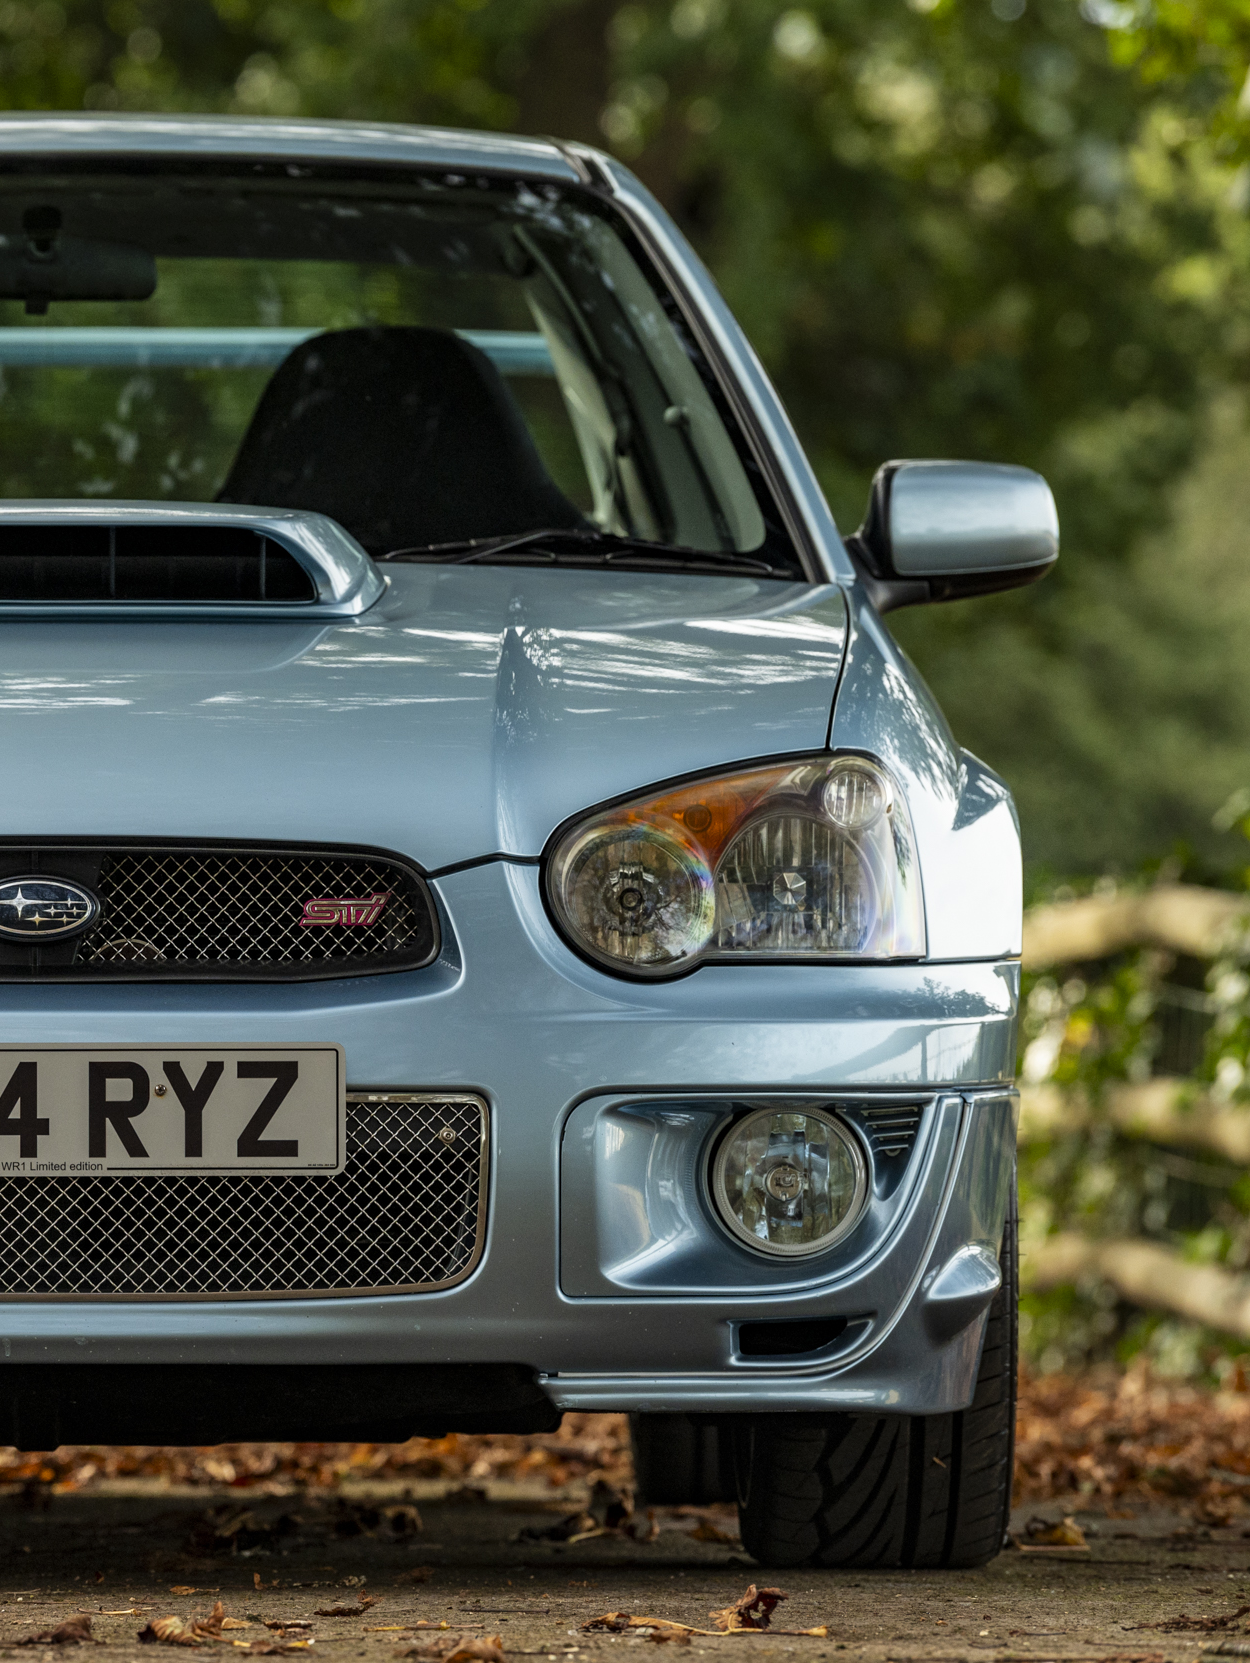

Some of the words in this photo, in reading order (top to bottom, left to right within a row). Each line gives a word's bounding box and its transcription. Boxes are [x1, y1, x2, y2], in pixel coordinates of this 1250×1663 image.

[88, 1061, 299, 1158] RYZ
[1, 1161, 26, 1171] WR1
[30, 1161, 67, 1171] Limited
[69, 1161, 104, 1171] edition
